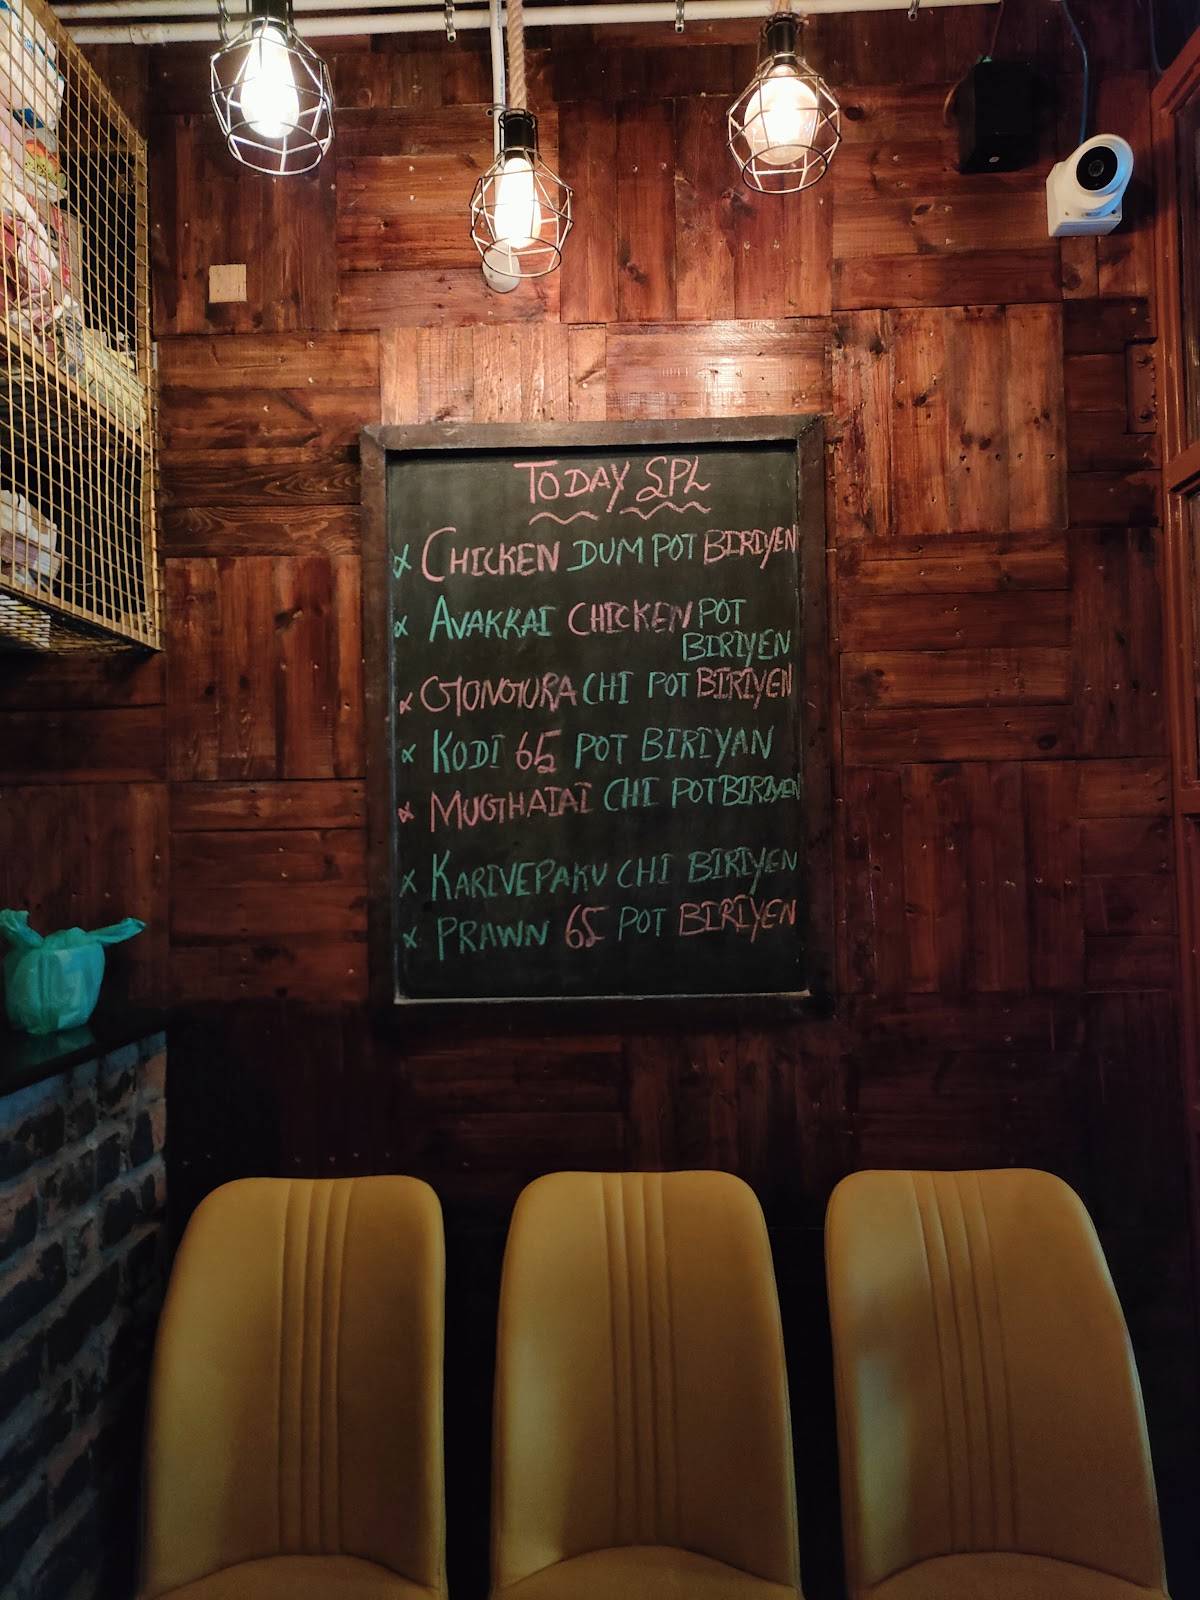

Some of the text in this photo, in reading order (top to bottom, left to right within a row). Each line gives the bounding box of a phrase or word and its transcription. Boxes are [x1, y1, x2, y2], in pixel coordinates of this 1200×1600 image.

[513, 456, 712, 513] TODAY SPL
[420, 527, 561, 582] CHICKEN
[567, 536, 644, 572] DUM
[651, 533, 698, 567] POT
[428, 595, 747, 643] AVAKKAI CHICKEN POT
[682, 628, 792, 667] BIRIYEN
[582, 671, 635, 705] CHI
[648, 671, 692, 699] POT
[432, 725, 775, 774] KODI 65 POT BIRIYAN
[604, 777, 660, 811] CHI
[671, 777, 718, 809] POT
[617, 853, 674, 888] CHI
[437, 894, 797, 961] PRAWN 65 POT BIRIYEN
